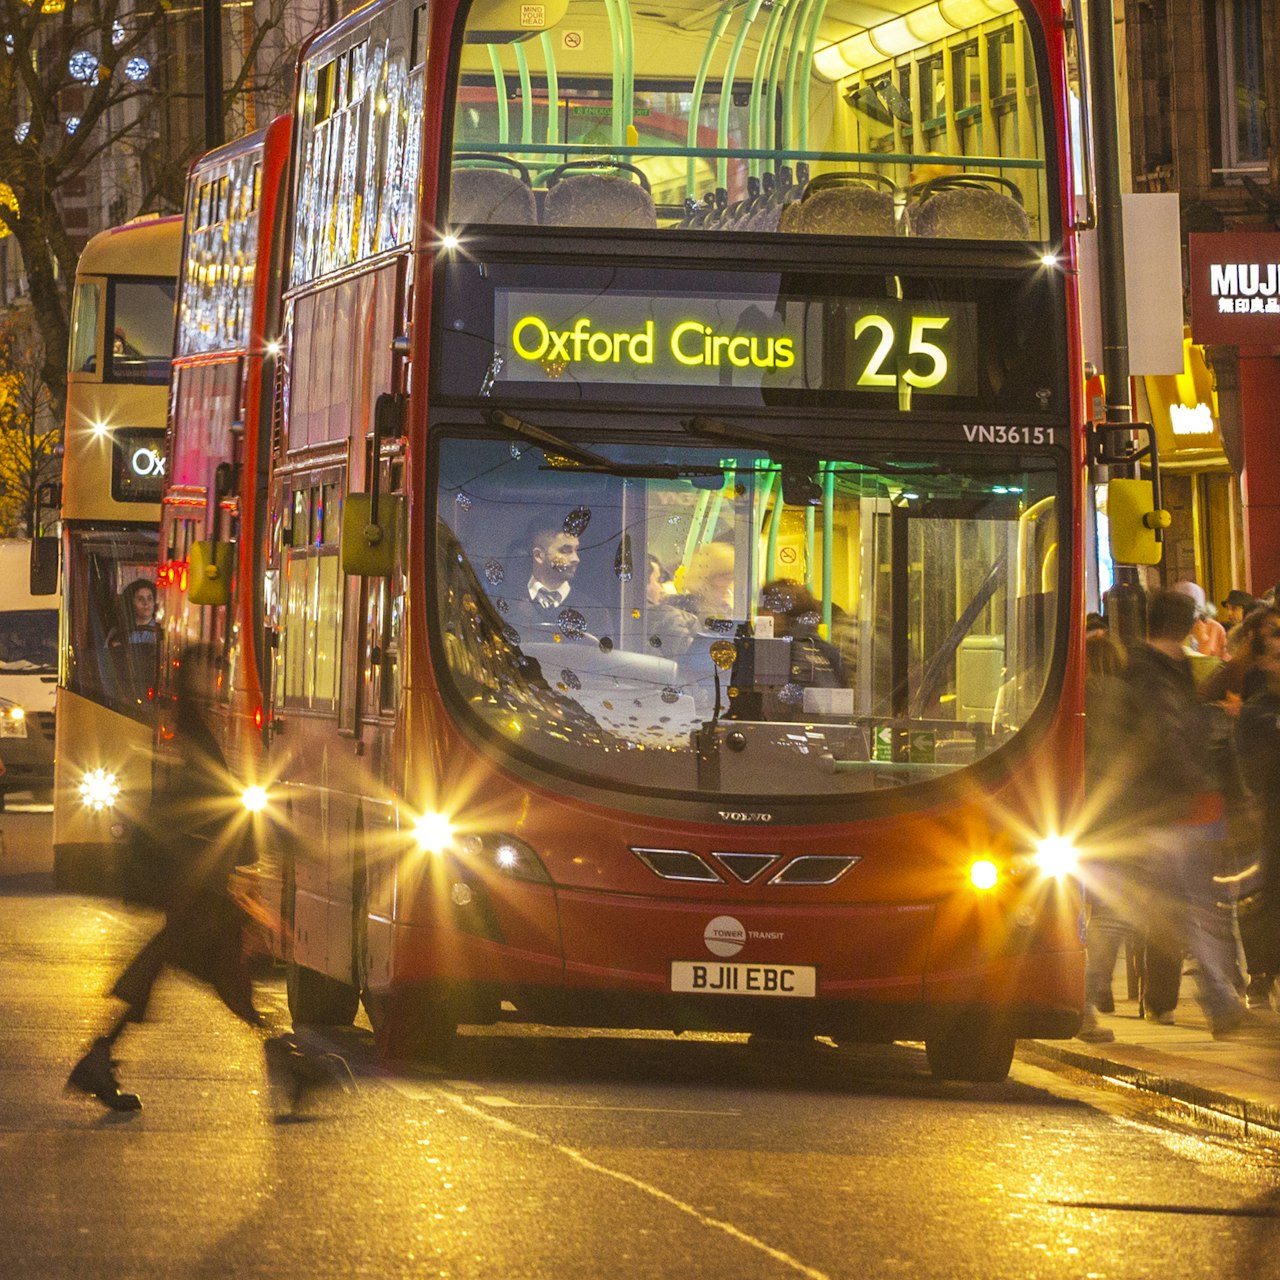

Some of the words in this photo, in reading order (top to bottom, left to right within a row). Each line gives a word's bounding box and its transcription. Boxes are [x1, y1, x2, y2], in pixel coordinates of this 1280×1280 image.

[1209, 263, 1280, 297] MUJ
[512, 315, 654, 365] Oxford
[670, 320, 795, 368] Circus
[854, 313, 951, 389] 25
[962, 424, 1055, 445] VN36151
[717, 809, 773, 822] VOLVO
[712, 928, 744, 938] TOWER
[747, 929, 785, 941] TRANSIT
[691, 964, 738, 991] BJ11
[745, 967, 796, 993] EBC
